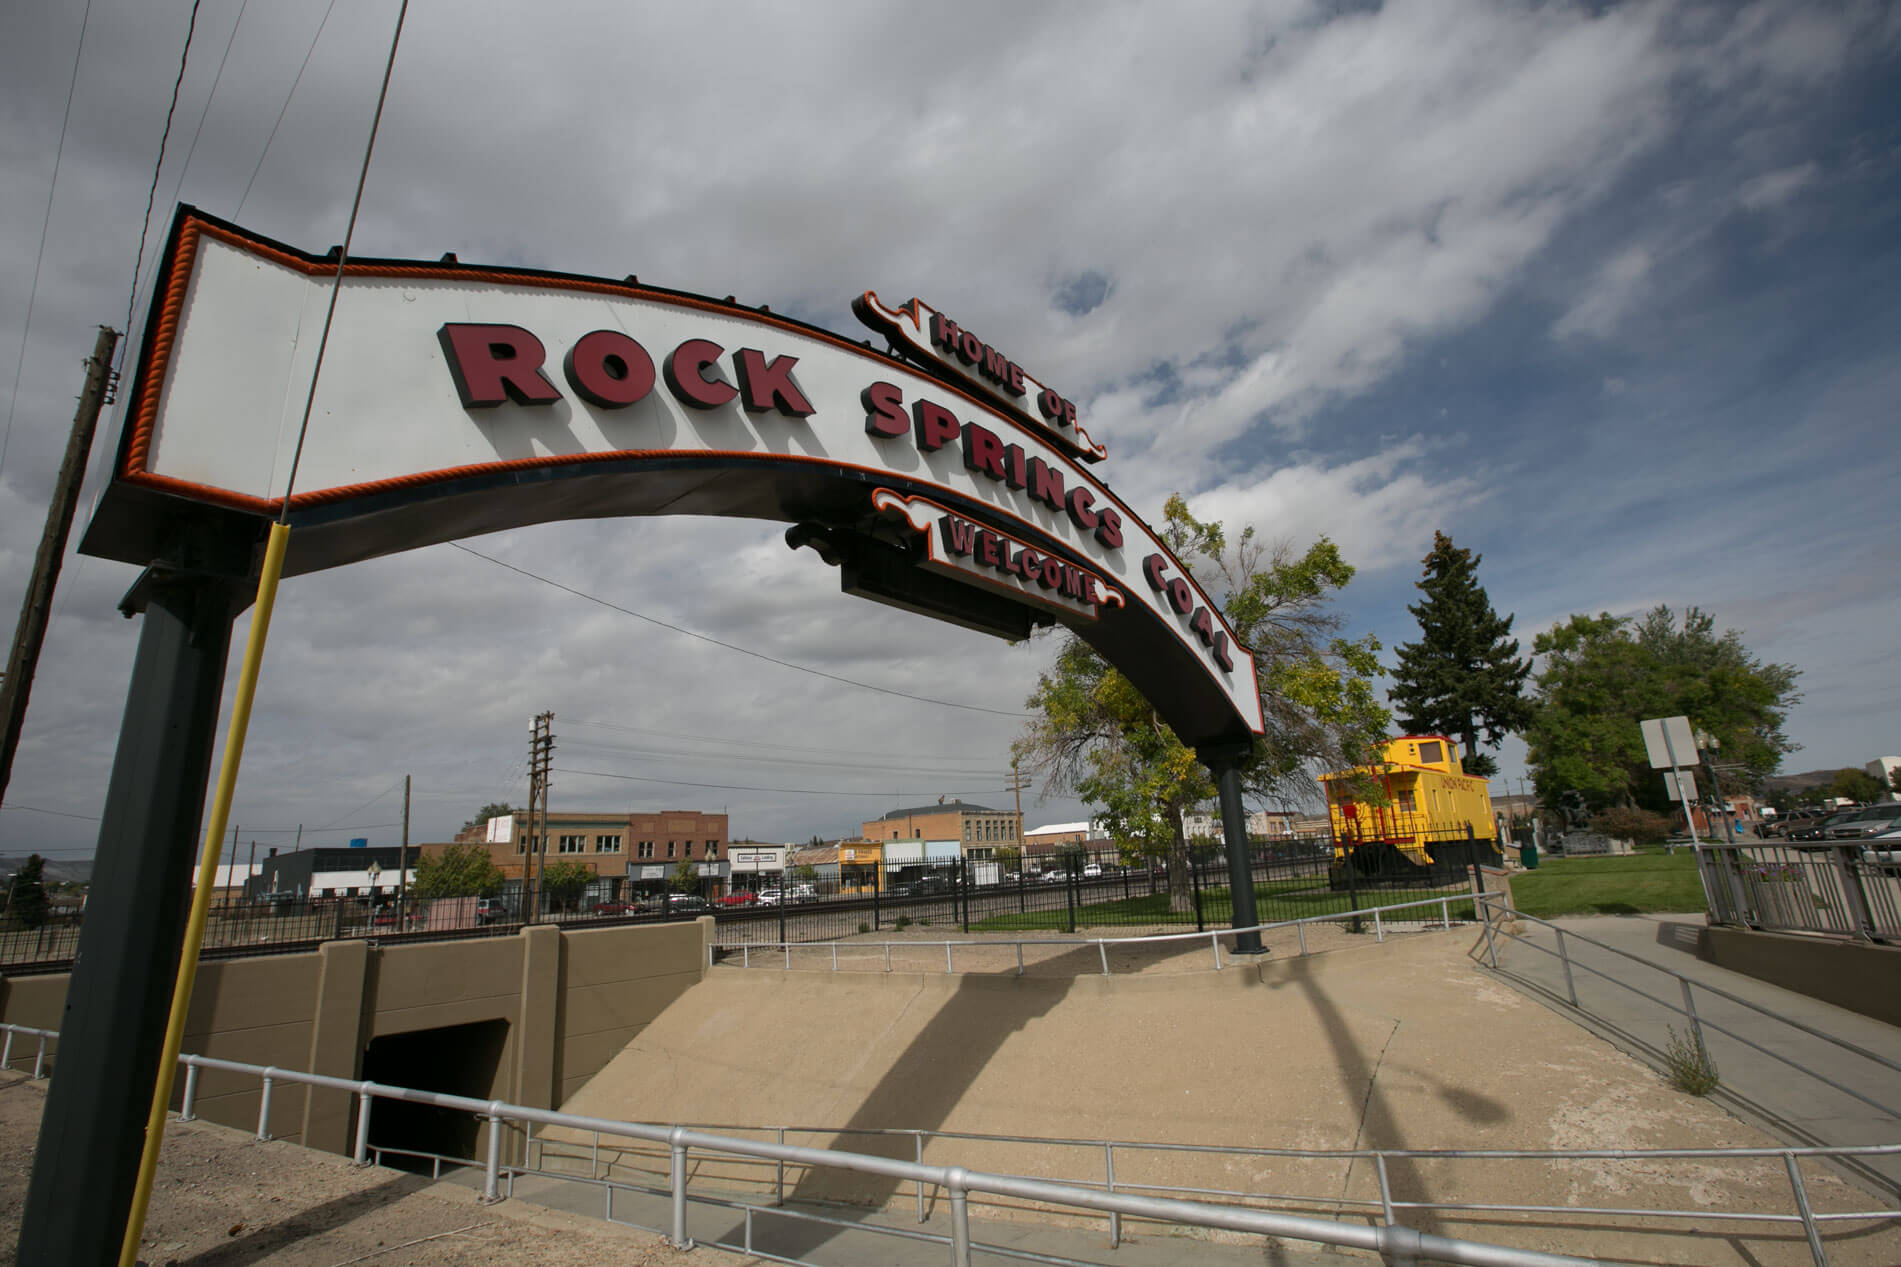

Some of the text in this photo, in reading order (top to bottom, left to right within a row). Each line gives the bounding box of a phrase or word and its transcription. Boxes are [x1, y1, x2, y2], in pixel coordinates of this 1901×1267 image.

[930, 312, 1077, 426] HOME OF
[437, 322, 1233, 673] ROCK SPRINGS COAL
[939, 515, 1098, 606] WELCOME
